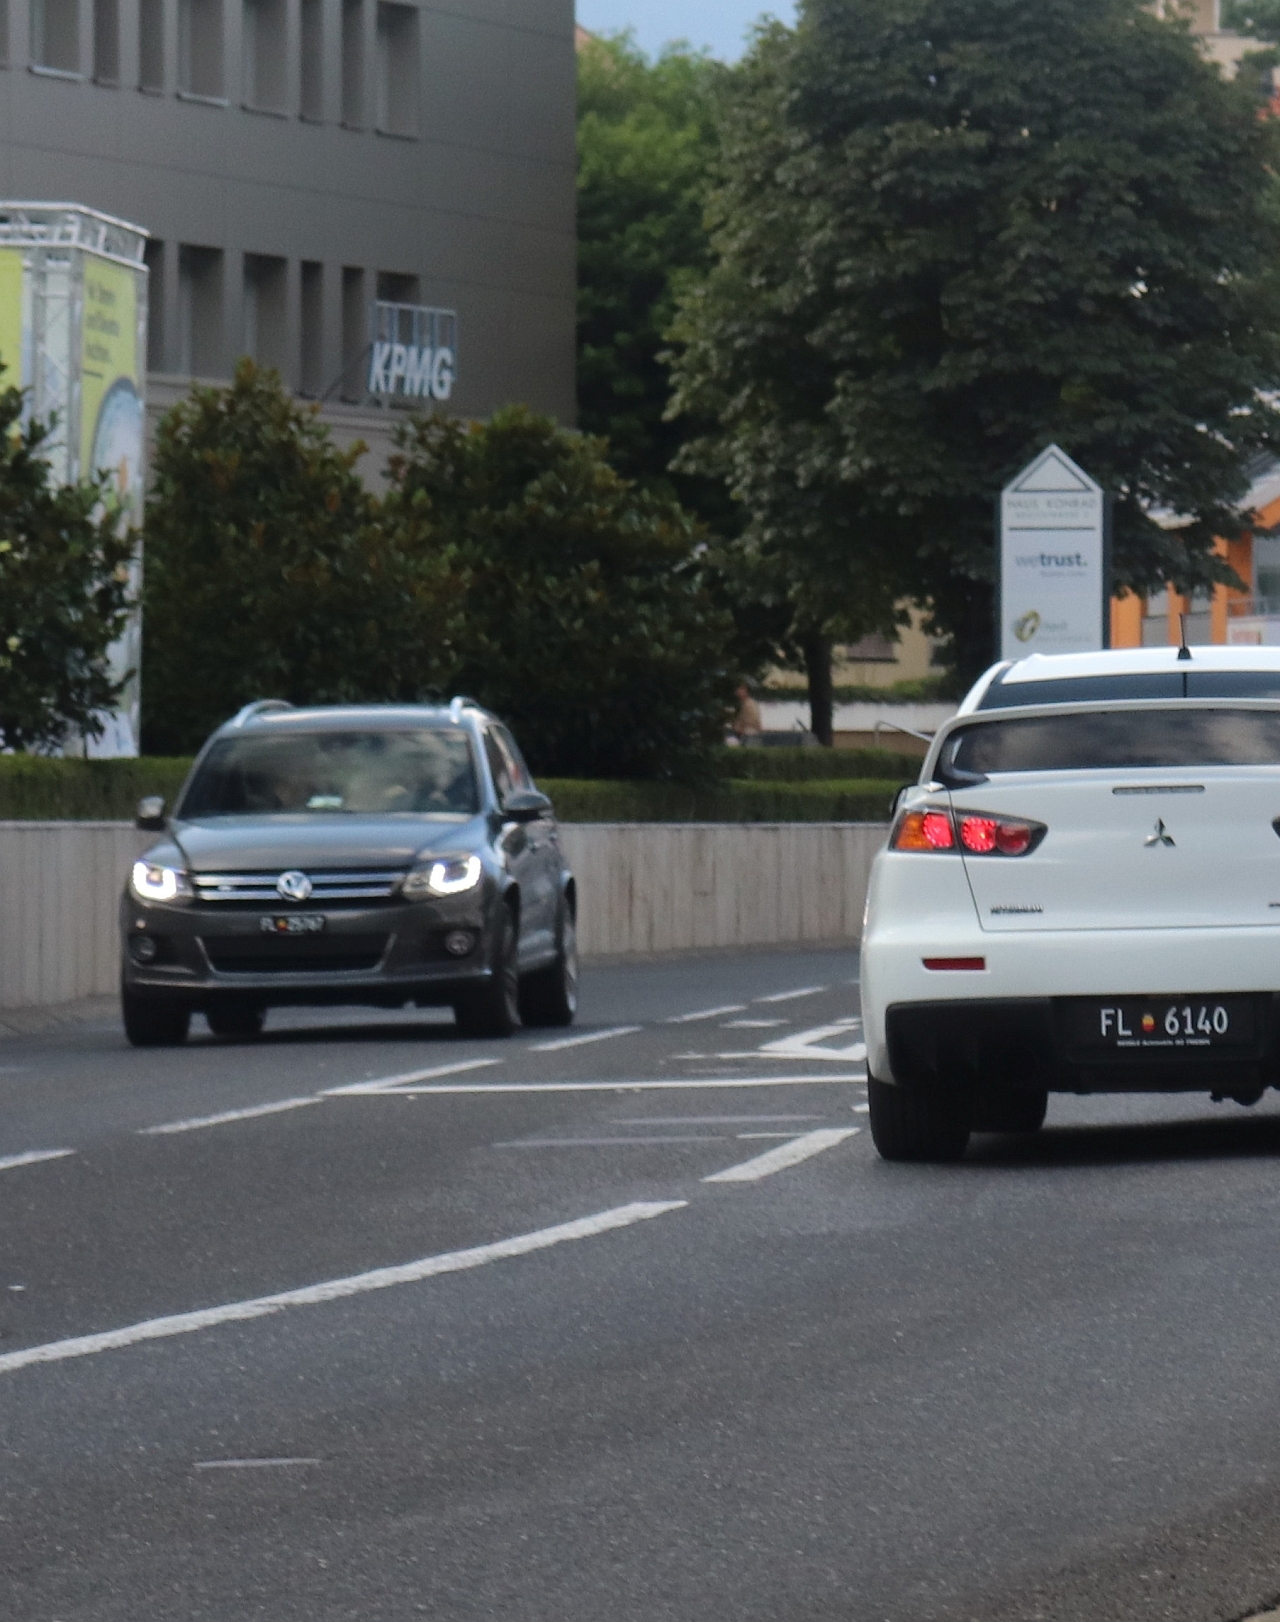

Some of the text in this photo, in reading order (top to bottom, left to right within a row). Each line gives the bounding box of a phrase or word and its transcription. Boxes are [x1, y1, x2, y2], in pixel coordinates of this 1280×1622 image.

[369, 341, 454, 400] KPMG
[1100, 1006, 1229, 1037] FL 6140
